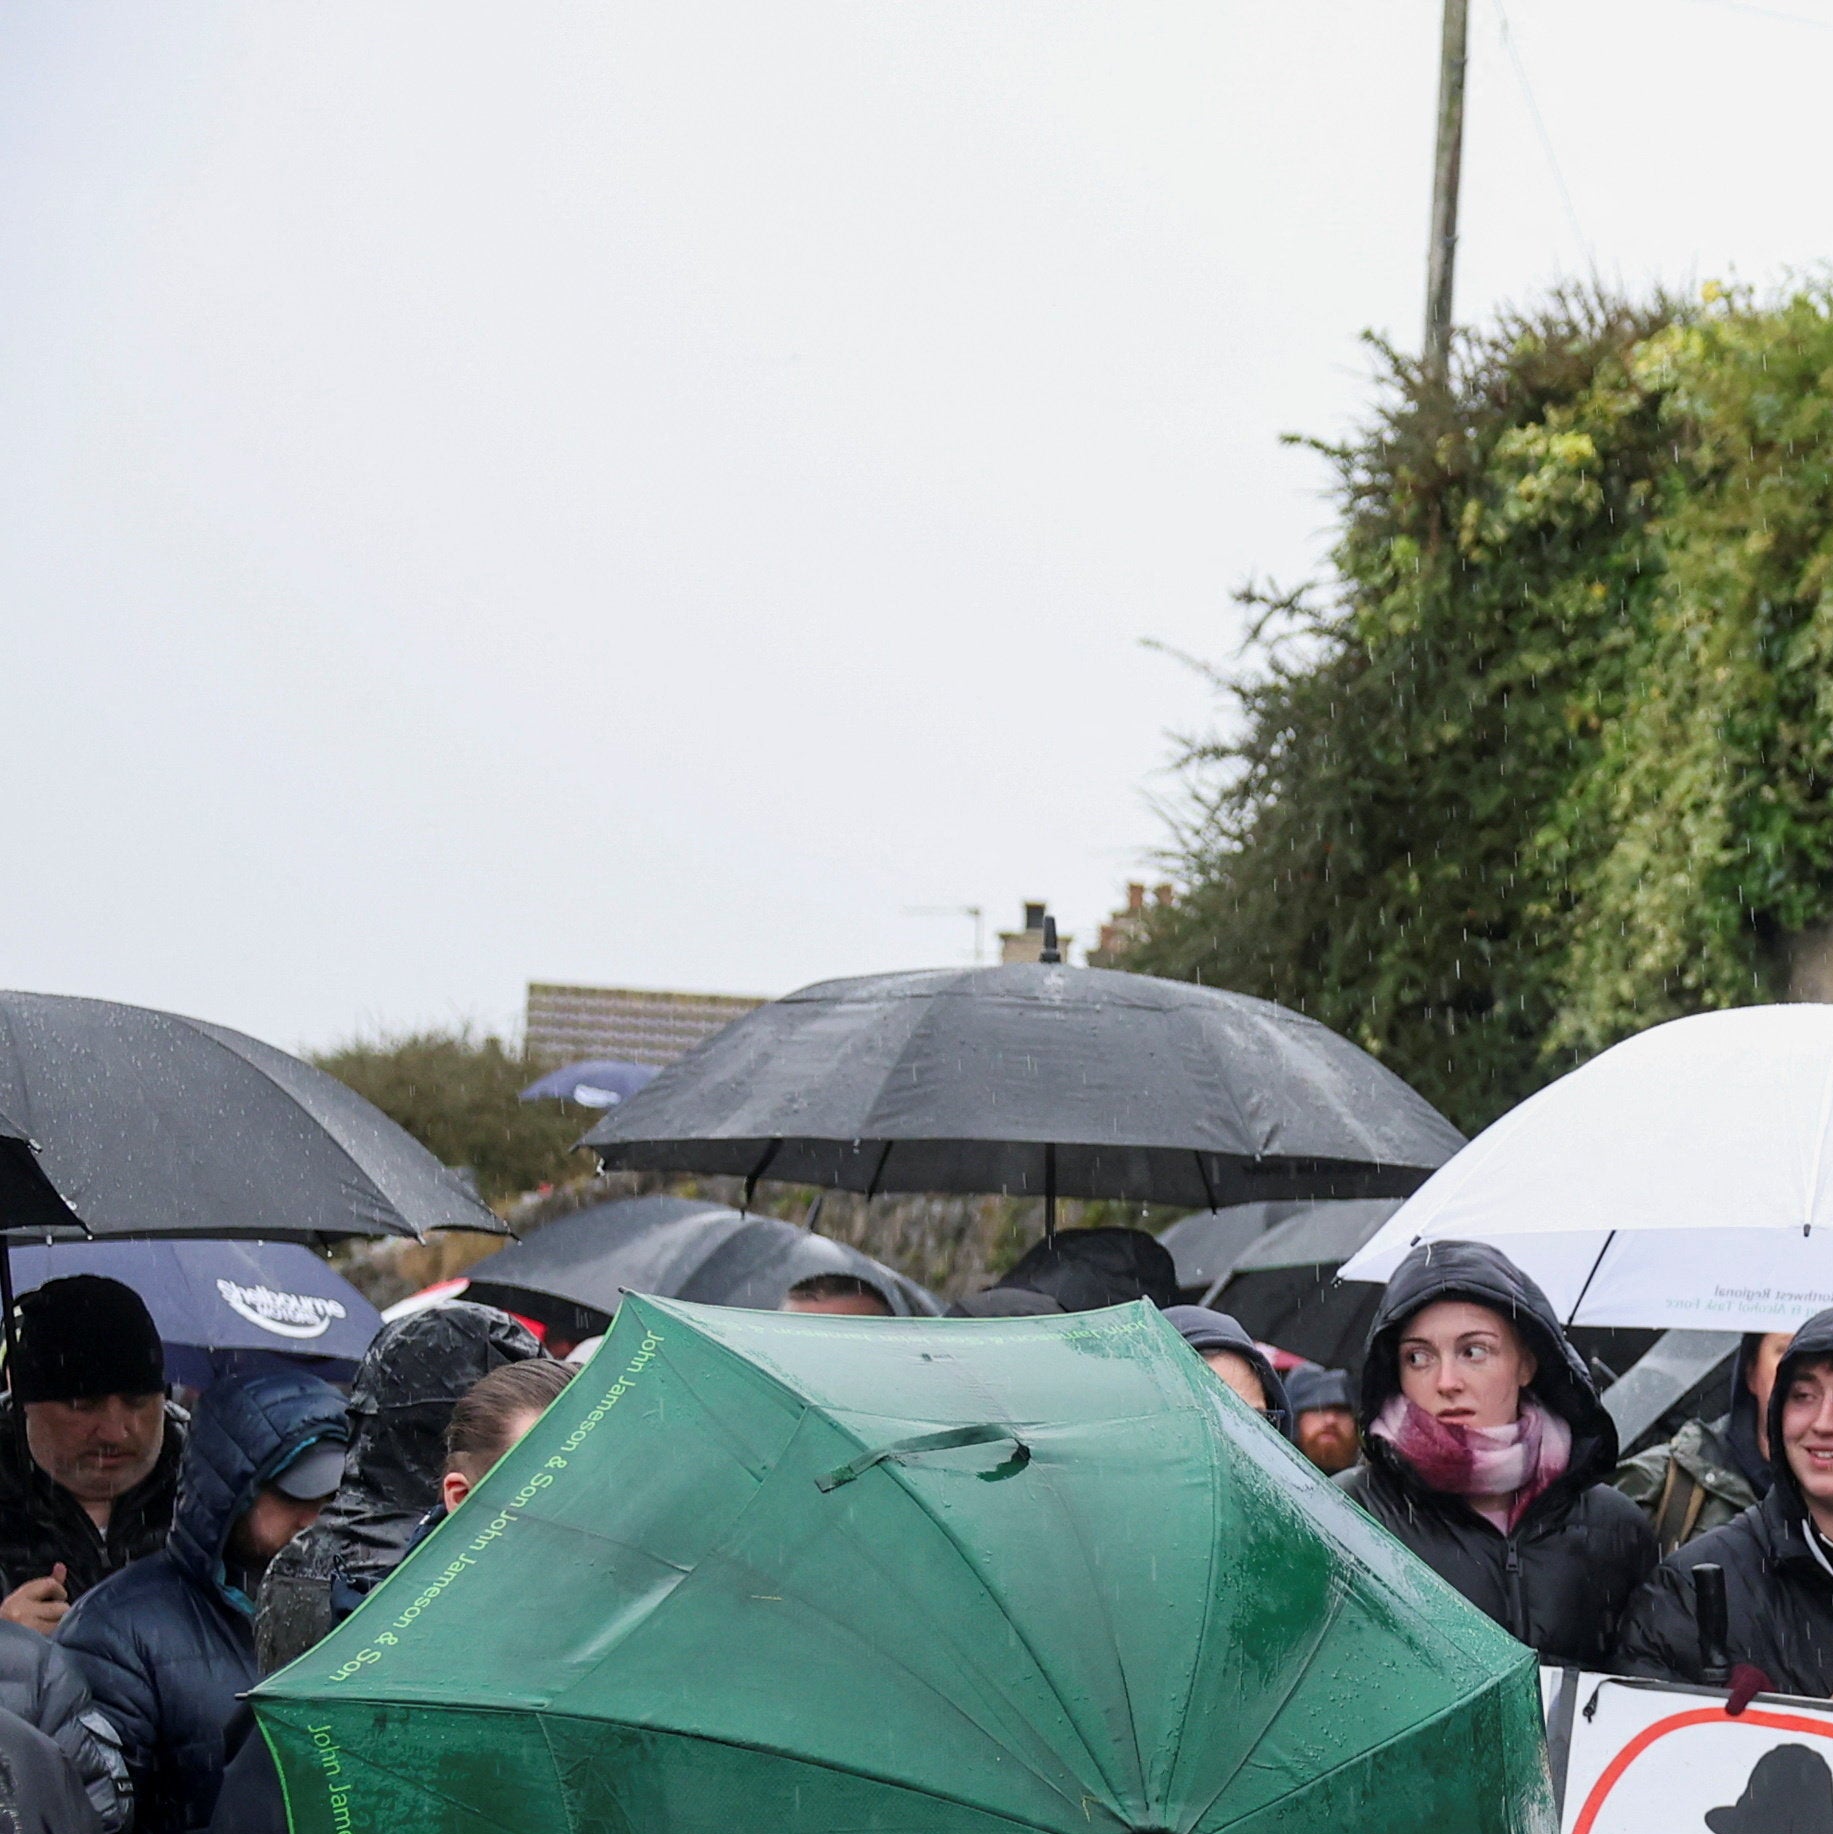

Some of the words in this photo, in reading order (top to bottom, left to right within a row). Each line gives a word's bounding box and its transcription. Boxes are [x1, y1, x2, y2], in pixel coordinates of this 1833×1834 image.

[216, 1278, 347, 1319] Shelbourne
[1103, 1318, 1148, 1338] John
[626, 1329, 665, 1373] John
[560, 1375, 637, 1452] Jameson
[544, 1455, 568, 1469] &
[509, 1472, 554, 1508] Son
[468, 1509, 519, 1551] John
[392, 1552, 478, 1629] Jameson
[373, 1631, 399, 1646] &
[328, 1648, 382, 1682] Son
[307, 1724, 342, 1777] John
